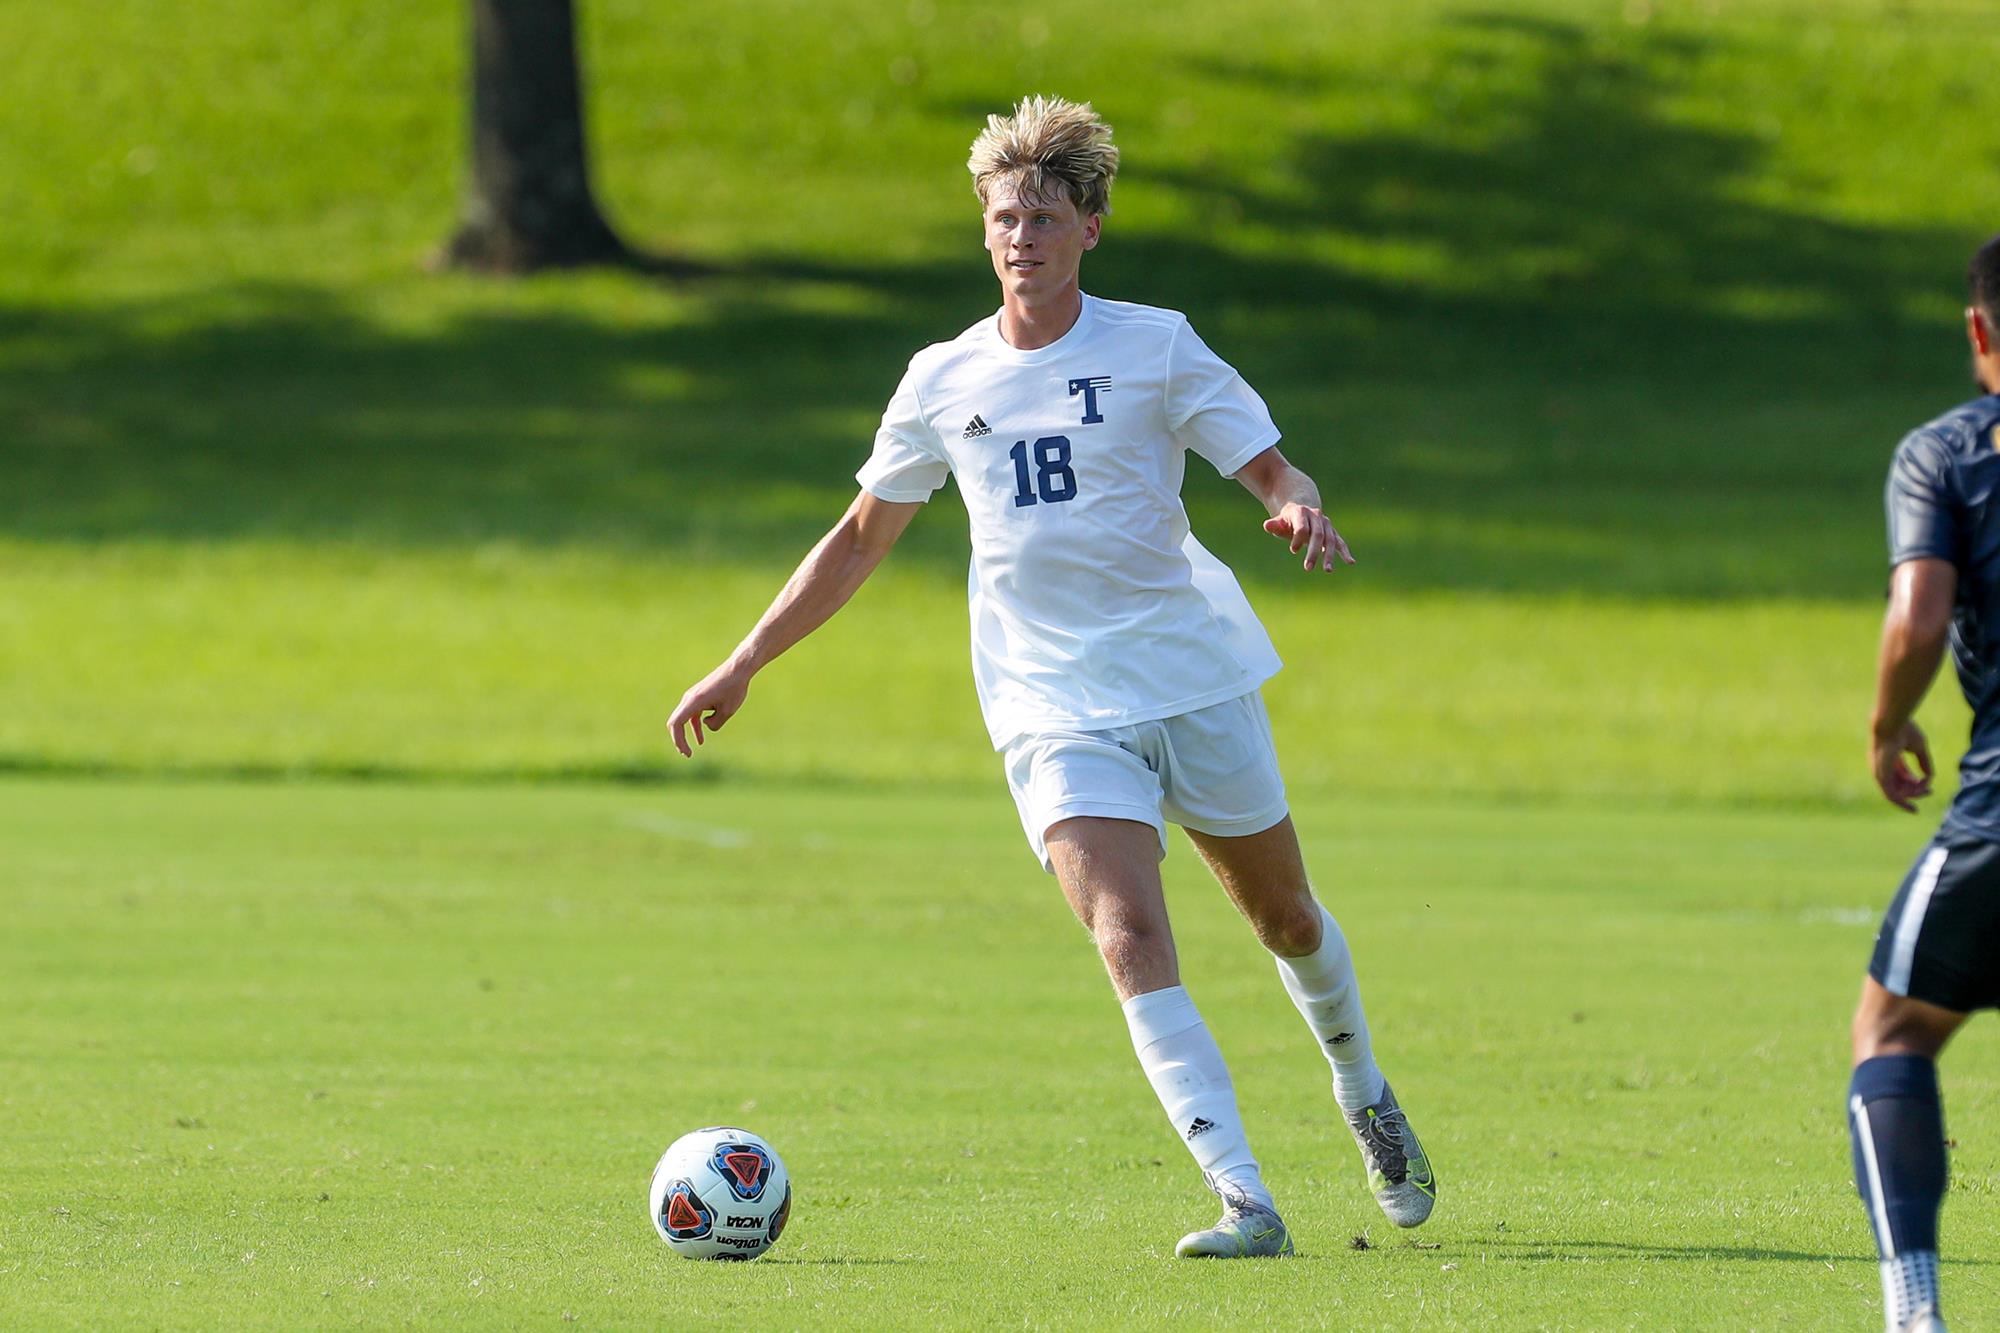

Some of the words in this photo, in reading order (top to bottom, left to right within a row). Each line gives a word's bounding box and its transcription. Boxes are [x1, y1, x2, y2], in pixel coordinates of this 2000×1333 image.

[1068, 375, 1112, 425] T
[962, 427, 993, 440] adidas
[1009, 435, 1078, 508] 18
[726, 1215, 764, 1229] NCAA
[716, 1235, 761, 1249] Wilson
